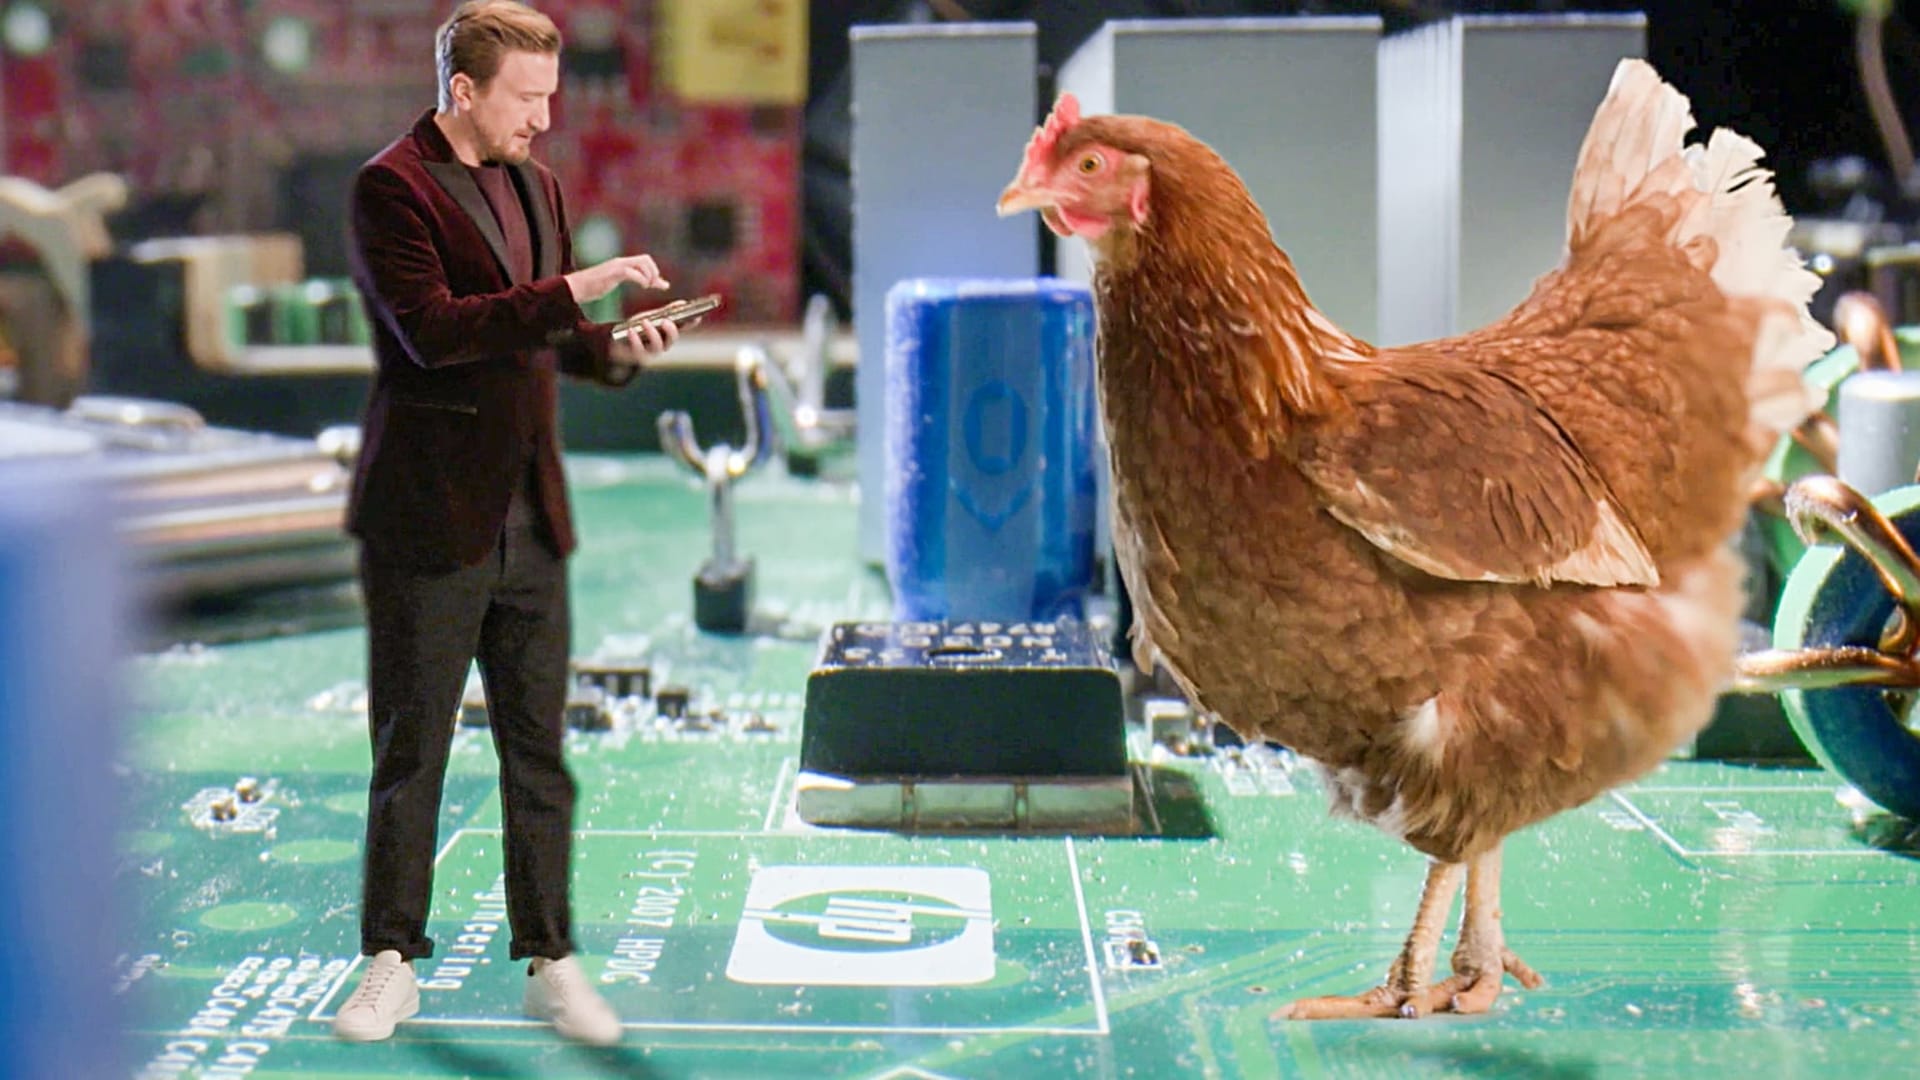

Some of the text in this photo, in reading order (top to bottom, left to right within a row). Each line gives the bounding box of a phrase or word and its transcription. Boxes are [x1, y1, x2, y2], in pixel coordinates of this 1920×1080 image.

[626, 879, 686, 928] 2007
[417, 873, 507, 990] gineering
[600, 938, 665, 984] HPDC
